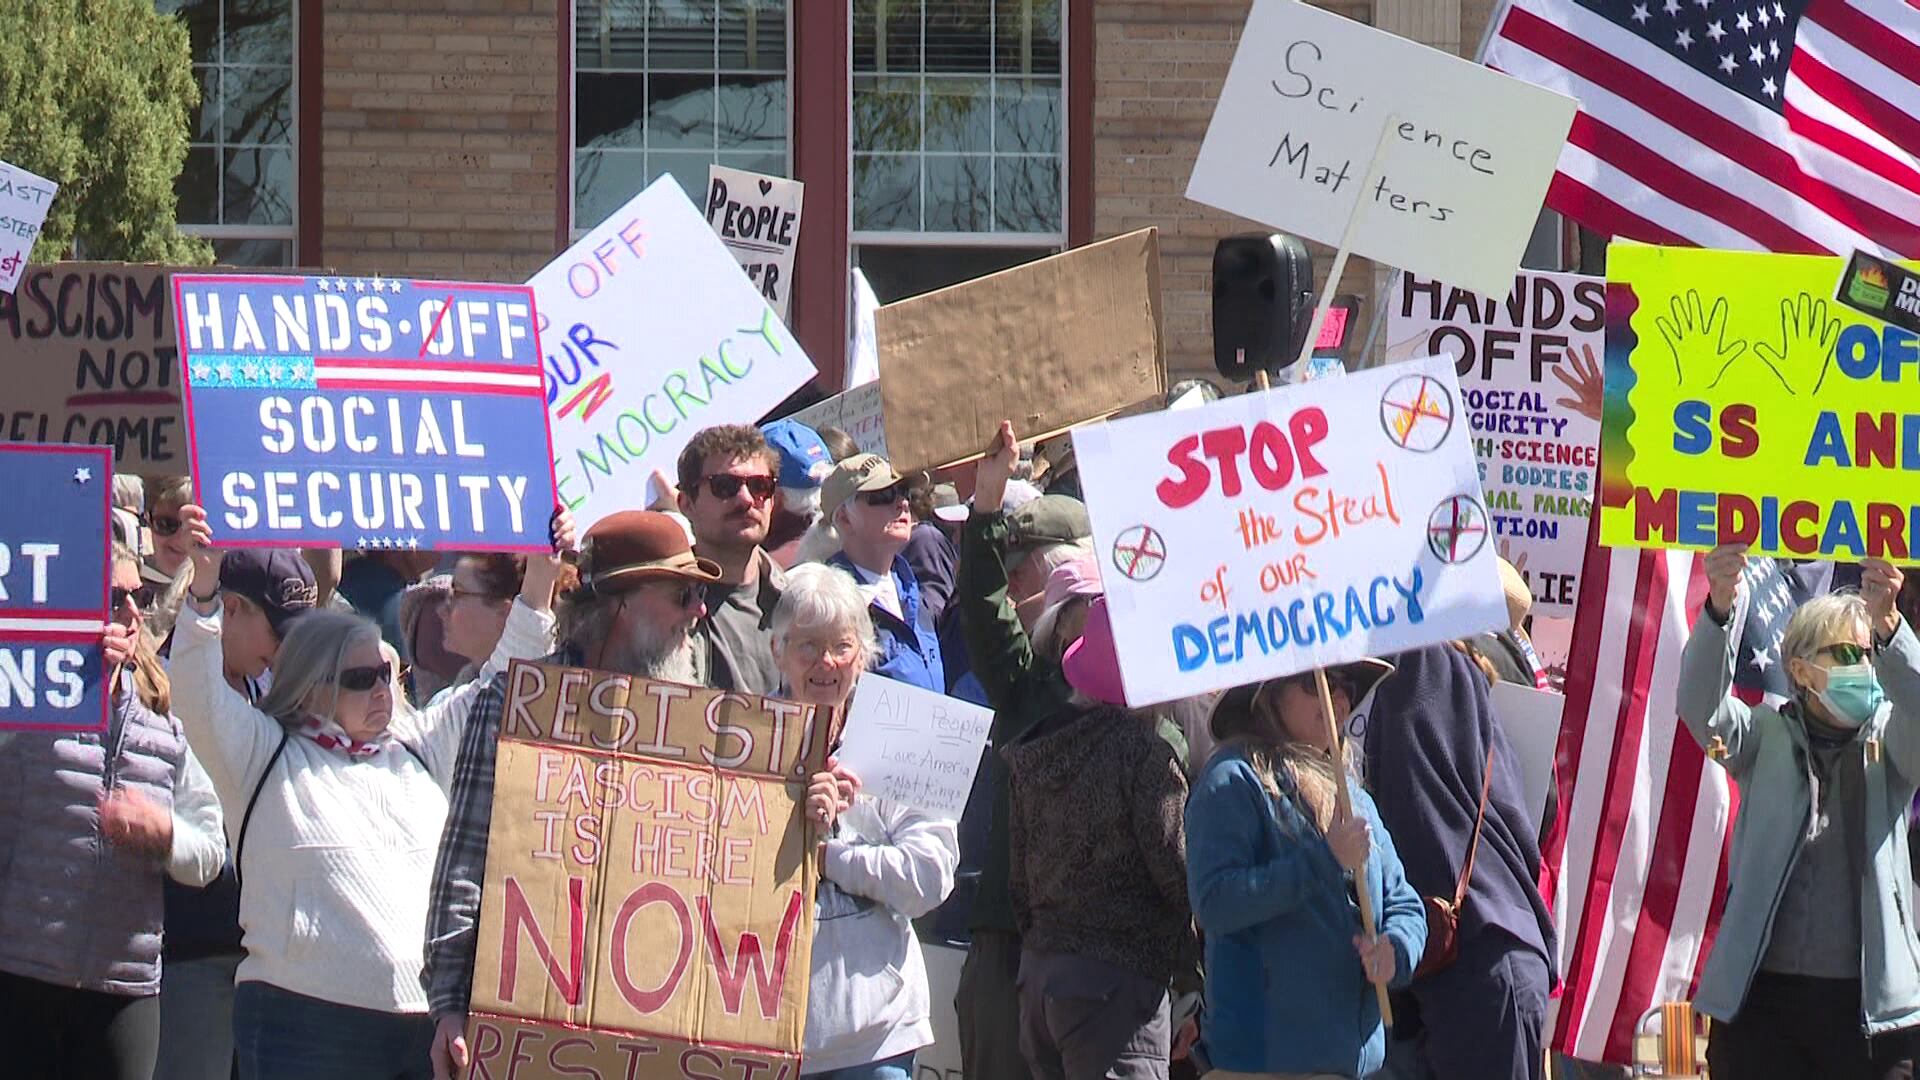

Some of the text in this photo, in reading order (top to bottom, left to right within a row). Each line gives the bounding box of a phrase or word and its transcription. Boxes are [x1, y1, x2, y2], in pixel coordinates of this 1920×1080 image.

[0, 180, 52, 204] AST
[707, 178, 796, 246] PEOPLE
[568, 218, 652, 299] OFF
[1401, 270, 1606, 333] HANDS
[76, 345, 178, 390] NOT
[1428, 325, 1569, 383] OFF
[1836, 324, 1920, 383] OF
[0, 410, 176, 462] ECOME
[259, 396, 486, 458] SOCIAL
[554, 307, 782, 511] EMOCRACY
[1465, 411, 1568, 438] CURITY
[1672, 399, 1760, 459] SS
[1155, 406, 1329, 509] STOP
[1502, 464, 1589, 492] BODIES
[221, 471, 528, 534] SECURITY
[1234, 460, 1401, 551] the Steal
[1199, 552, 1319, 609] of OUR
[1171, 564, 1426, 673] DEMOCRACY
[504, 659, 817, 777] RESIST!
[874, 689, 985, 740] All People
[534, 752, 769, 836] FASCISM
[533, 810, 755, 886] IS HERE
[496, 874, 805, 1021] NOW
[469, 1022, 794, 1080] RESI
